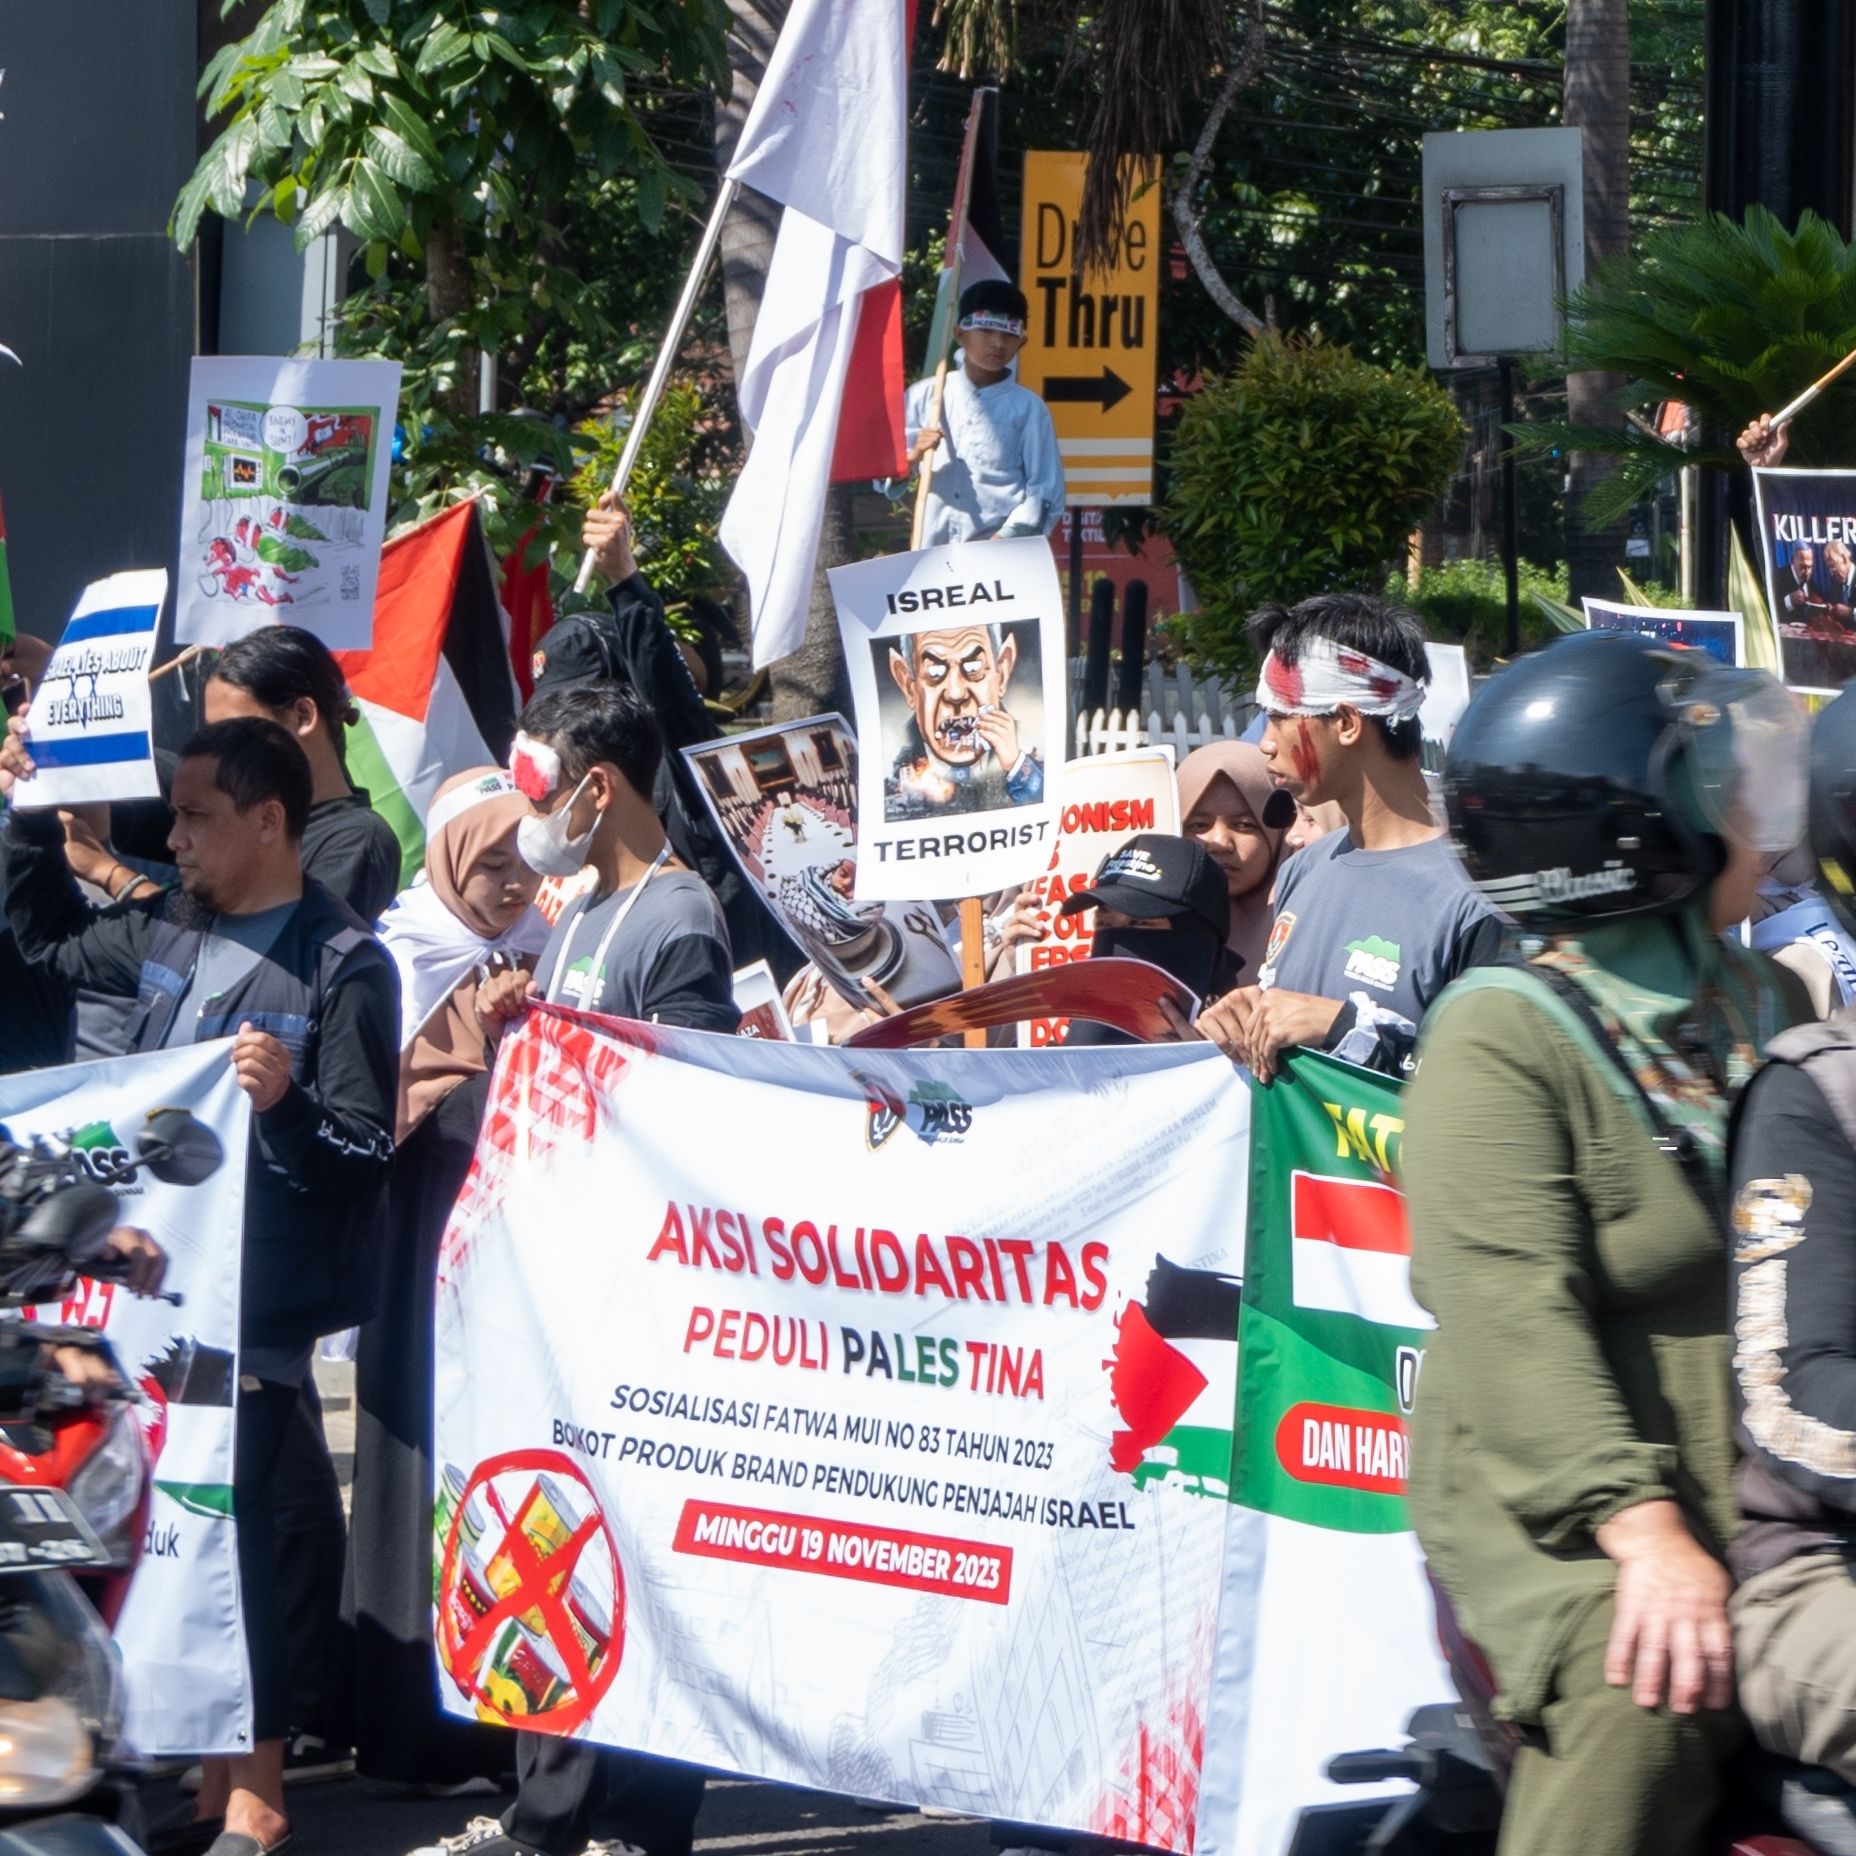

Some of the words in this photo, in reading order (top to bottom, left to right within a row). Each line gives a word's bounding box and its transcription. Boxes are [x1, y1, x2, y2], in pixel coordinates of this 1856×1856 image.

[1036, 275, 1145, 349] Thru
[886, 580, 1015, 615] ISREAL
[103, 646, 148, 675] ABOUT
[47, 694, 124, 726] EVERYTHING
[874, 820, 1050, 862] TERRORIST
[920, 1099, 973, 1136] PASS
[646, 1200, 760, 1275] AKSI
[762, 1216, 1110, 1313] SOLIDARITAS
[683, 1306, 829, 1371] PEDULI
[839, 1325, 1045, 1400] PALESTINA
[610, 1384, 760, 1429] SOSIALISASI
[763, 1404, 839, 1441] FATWA
[843, 1415, 881, 1445] MUI
[885, 1420, 915, 1450] NO
[918, 1425, 941, 1454] 83
[946, 1428, 1010, 1465] TAHUN
[1012, 1438, 1055, 1471] 2023
[1302, 1418, 1352, 1472] DAN
[1355, 1432, 1412, 1481] HAR
[618, 1436, 728, 1477] PRODUK
[731, 1452, 809, 1489] BRAND
[811, 1464, 938, 1508] PENDUKUNG
[942, 1482, 1038, 1524] PENJAJAH
[1040, 1495, 1136, 1530] ISRAEL
[693, 1513, 798, 1556] MINGGU
[799, 1528, 824, 1561] 19
[827, 1531, 952, 1581] NOVEMBER
[952, 1551, 1001, 1591] 2023
